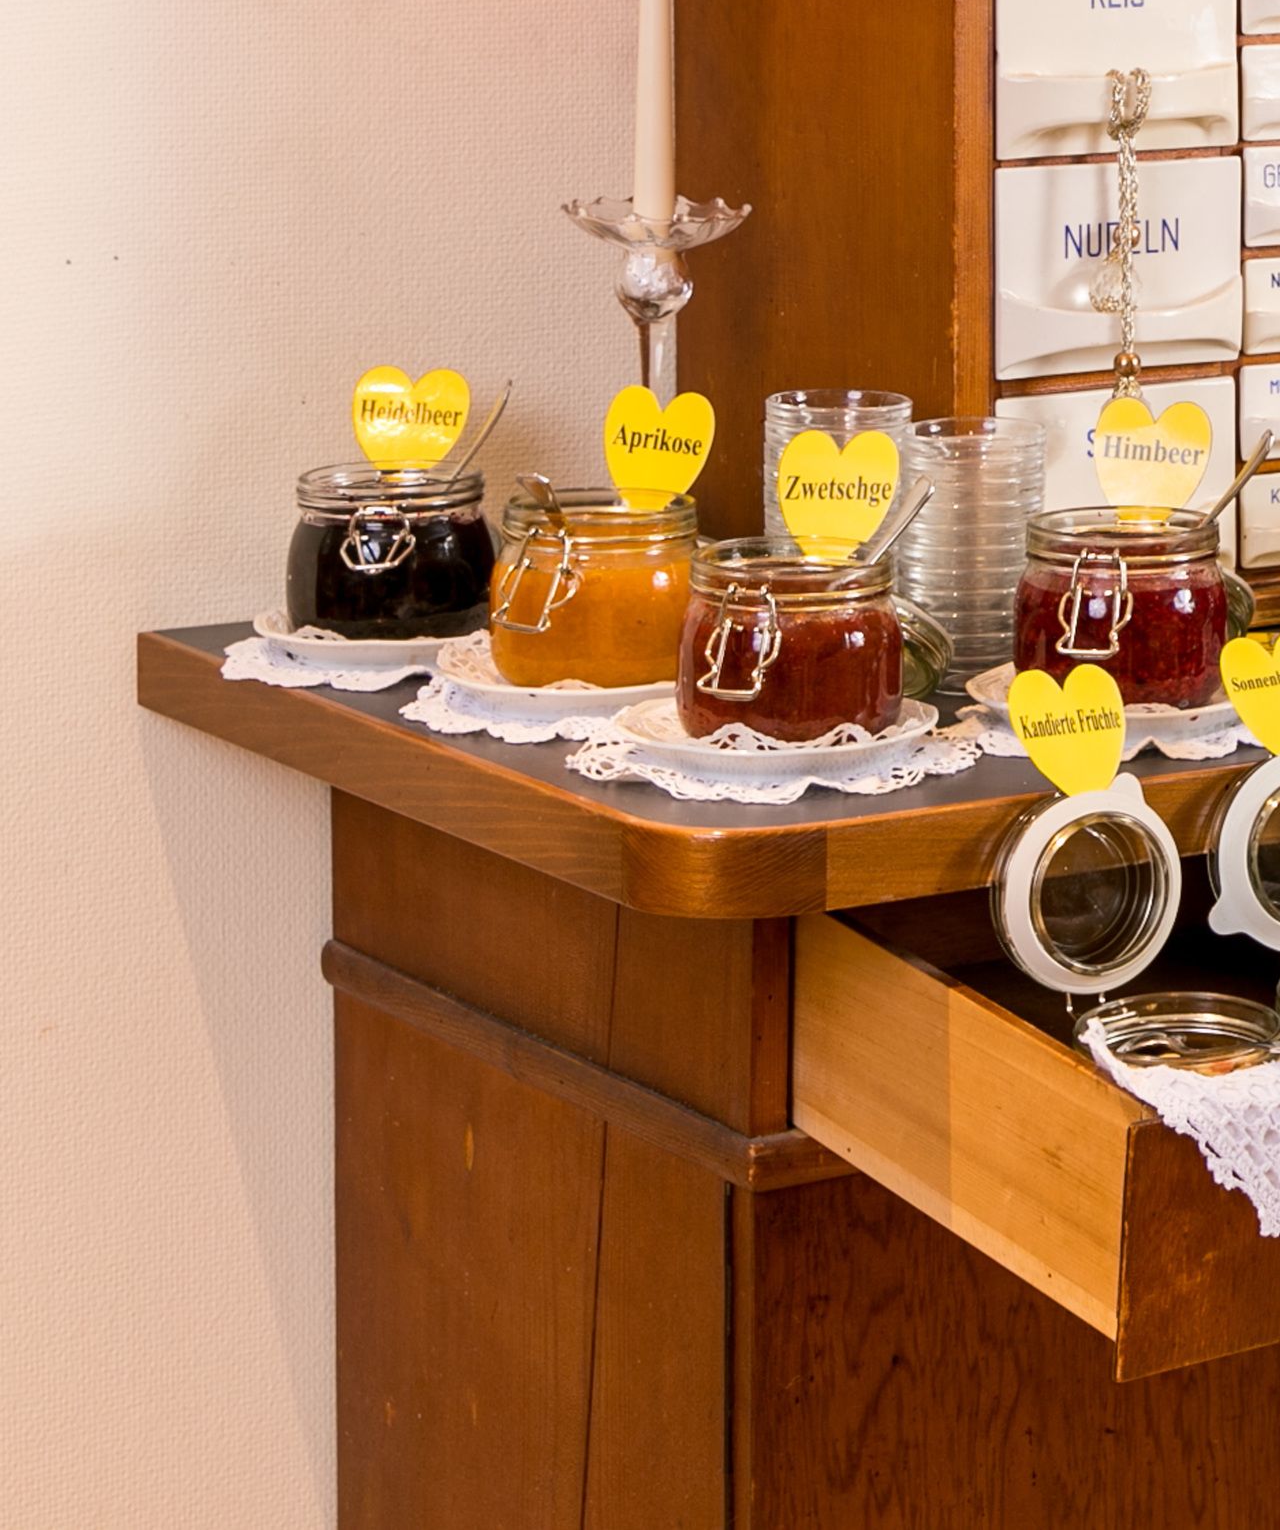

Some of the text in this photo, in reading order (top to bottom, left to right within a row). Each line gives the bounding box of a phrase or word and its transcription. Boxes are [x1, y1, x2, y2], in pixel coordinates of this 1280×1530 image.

[1064, 217, 1180, 259] NULN
[360, 399, 463, 428] Heidelbeer
[612, 423, 703, 457] Aprikose
[1103, 434, 1205, 467] Himbeer
[784, 475, 892, 507] Zwetschge
[1019, 707, 1121, 741] Kandierte Früchte
